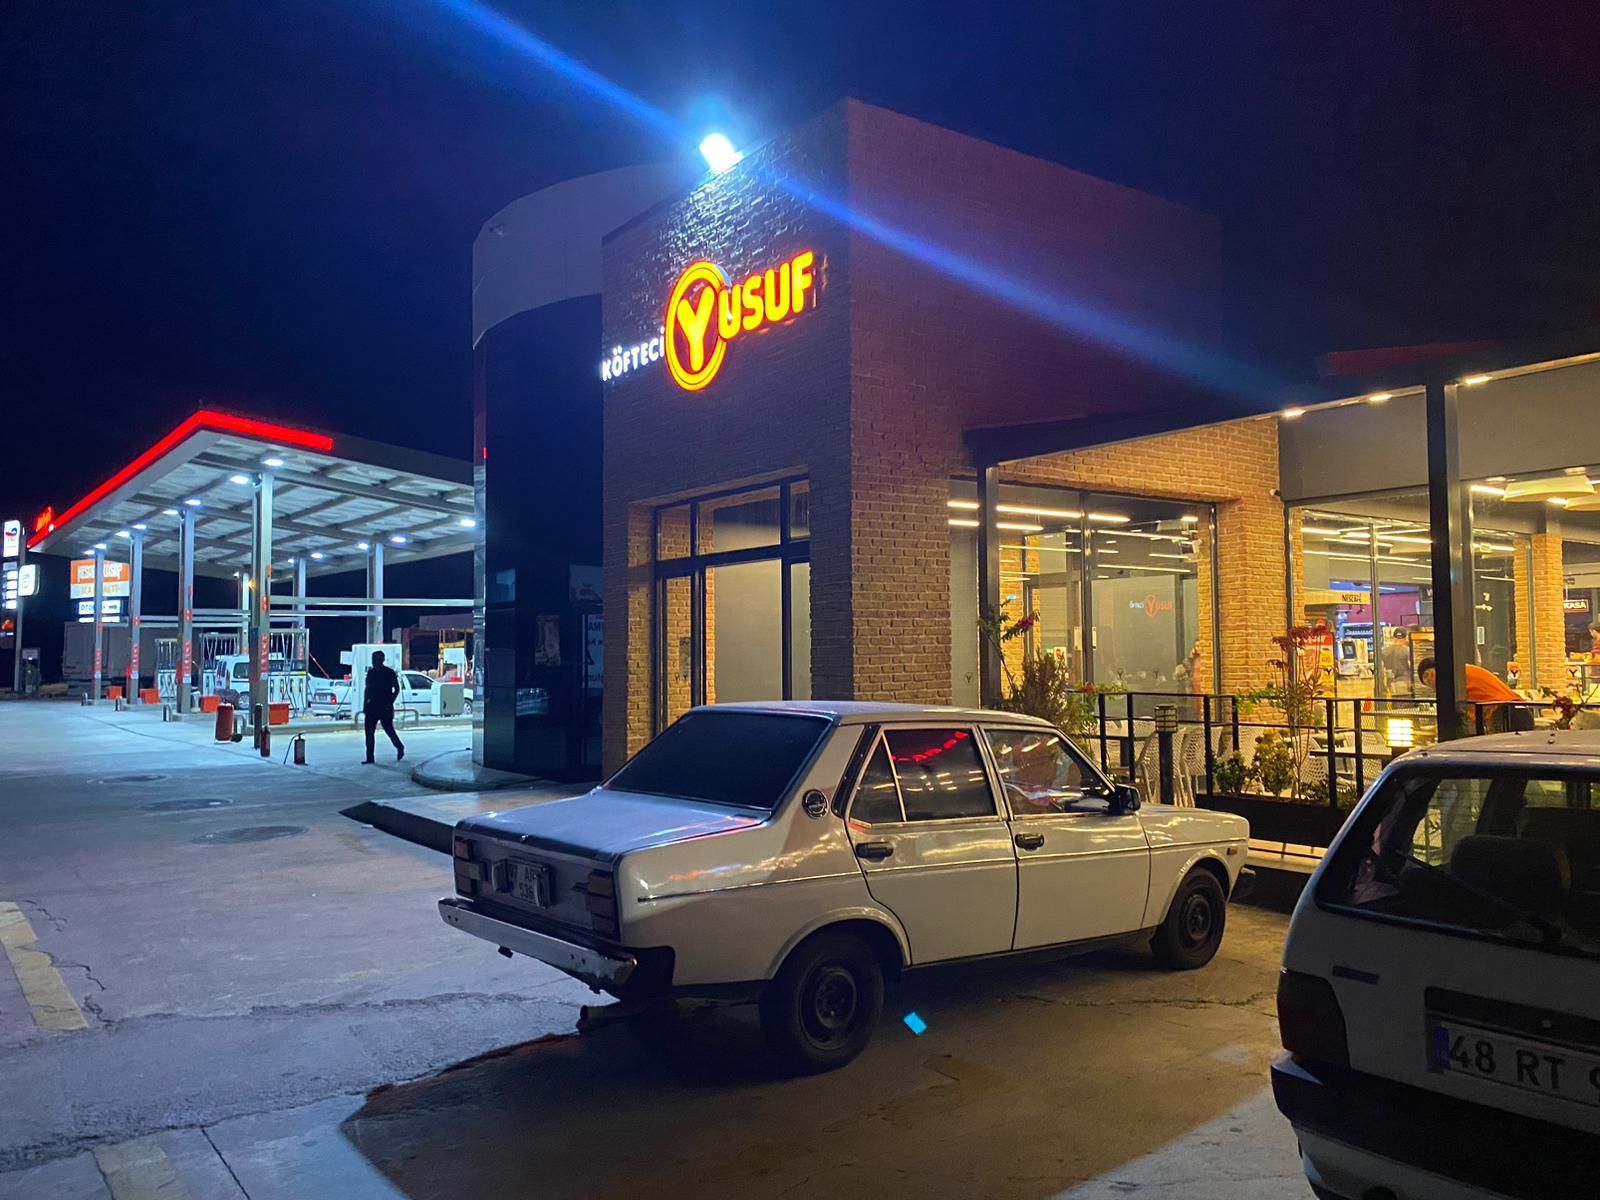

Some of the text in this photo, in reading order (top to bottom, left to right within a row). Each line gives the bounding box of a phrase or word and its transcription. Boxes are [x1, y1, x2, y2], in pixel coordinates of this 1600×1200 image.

[601, 250, 814, 382] KÖFTECİ YUSUF
[1450, 1035, 1496, 1073] 48
[1515, 1050, 1567, 1089] RT
